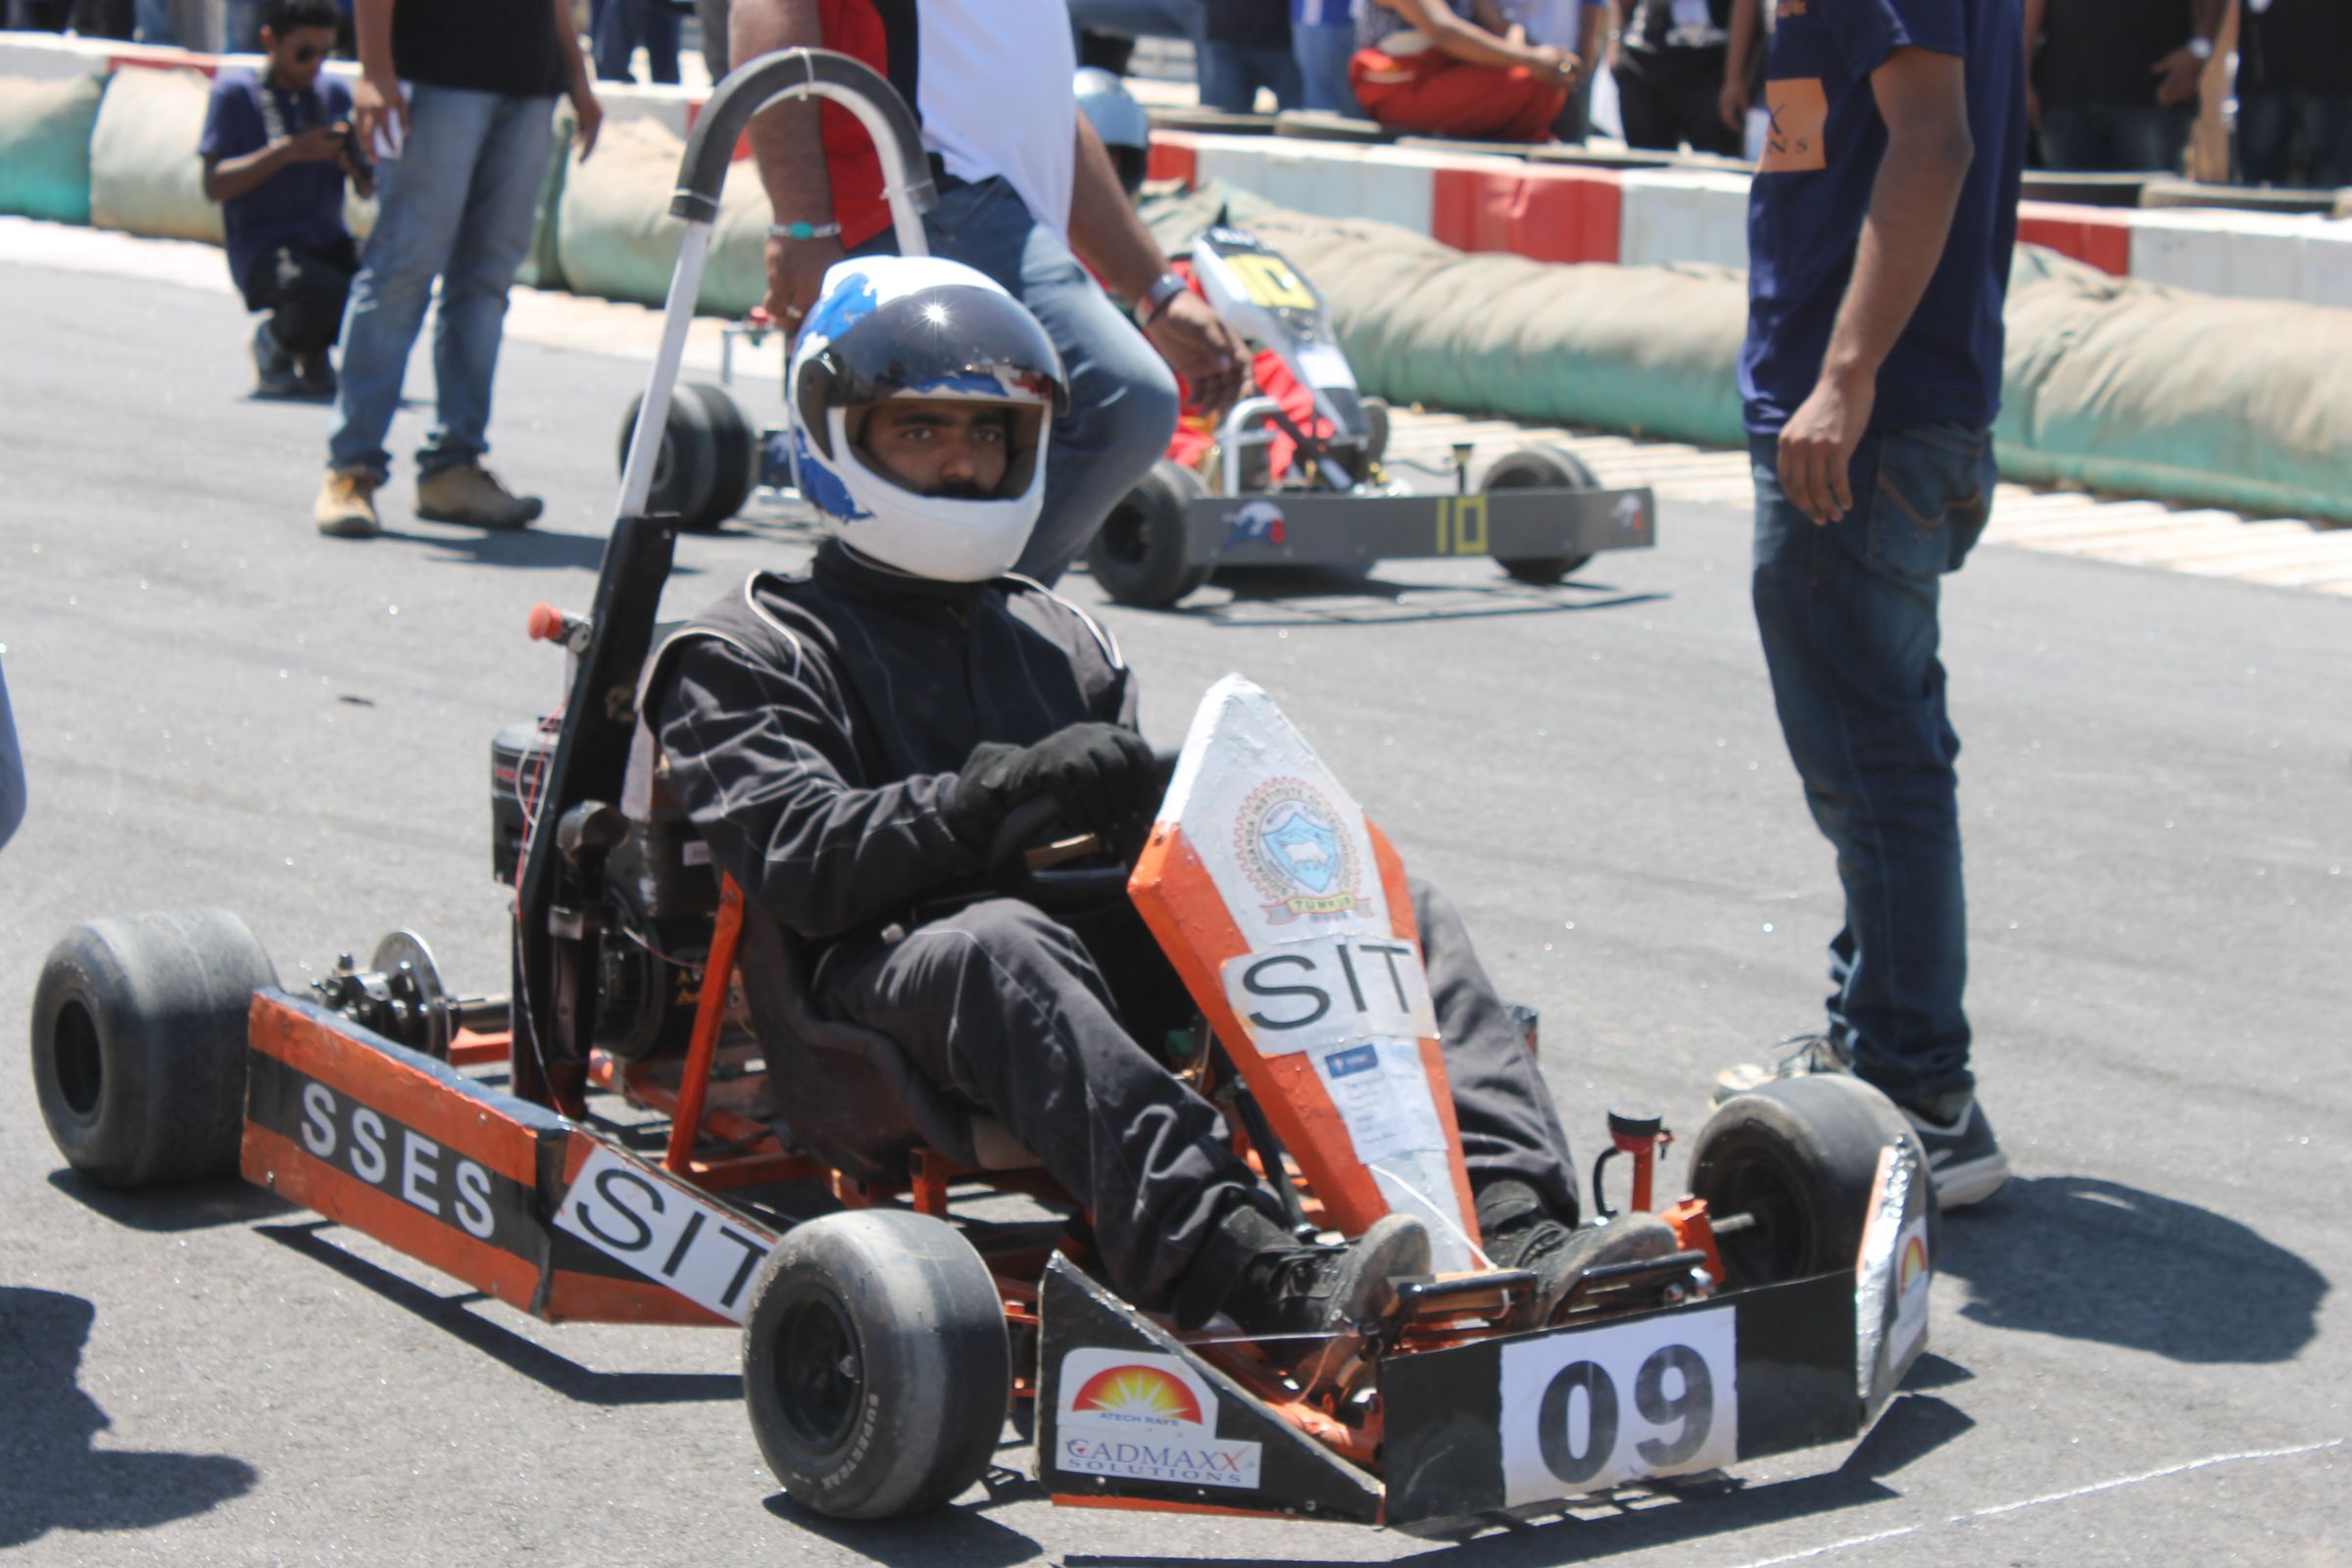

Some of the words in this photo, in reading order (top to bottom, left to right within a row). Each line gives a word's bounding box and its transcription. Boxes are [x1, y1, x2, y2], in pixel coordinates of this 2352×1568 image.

[1436, 494, 1488, 555] 10
[1242, 943, 1412, 1031] SIT
[300, 1081, 495, 1239] SSES
[575, 1167, 768, 1310] SIT
[1098, 1412, 1142, 1423] ATECH
[1144, 1417, 1180, 1427] RAYS
[1538, 1344, 1713, 1485] 09
[1065, 1438, 1252, 1473] CADMAXX
[1068, 1458, 1242, 1484] SOLUTIONS
